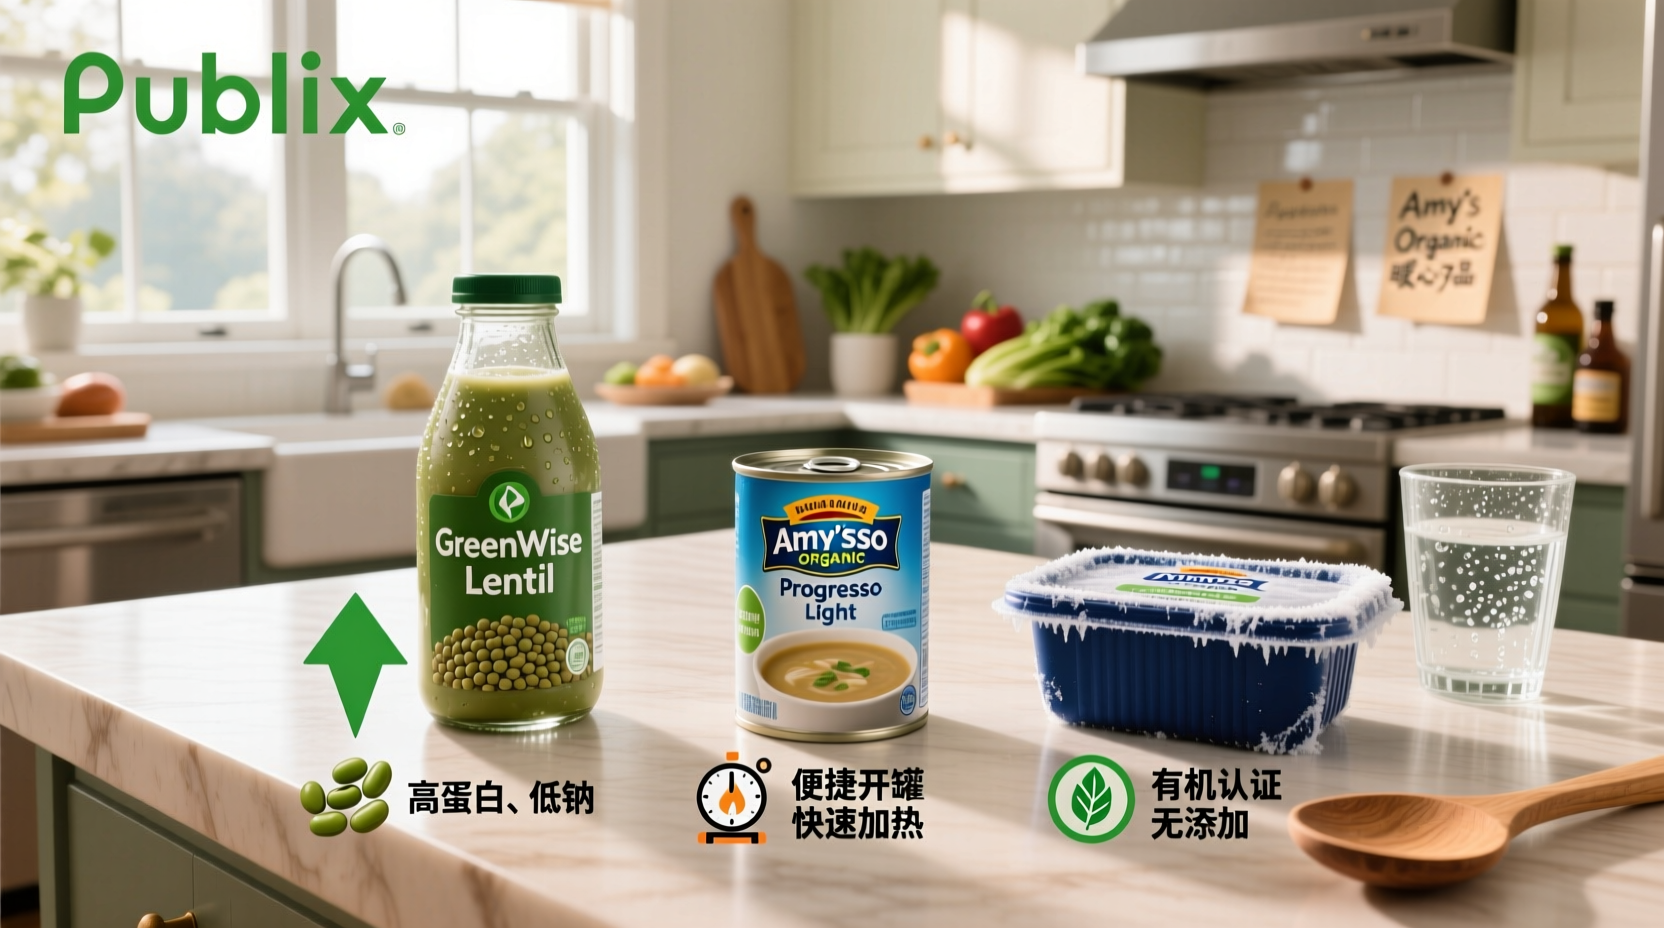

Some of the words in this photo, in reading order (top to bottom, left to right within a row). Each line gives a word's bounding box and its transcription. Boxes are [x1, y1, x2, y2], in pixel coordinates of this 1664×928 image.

[1399, 189, 1481, 225] Amy's
[1394, 226, 1484, 260] Organic
[435, 527, 583, 558] GreenWise
[798, 551, 866, 567] ORGANIC
[465, 562, 554, 596] Lentil
[780, 577, 882, 602] Progresso
[805, 603, 857, 626] Light
